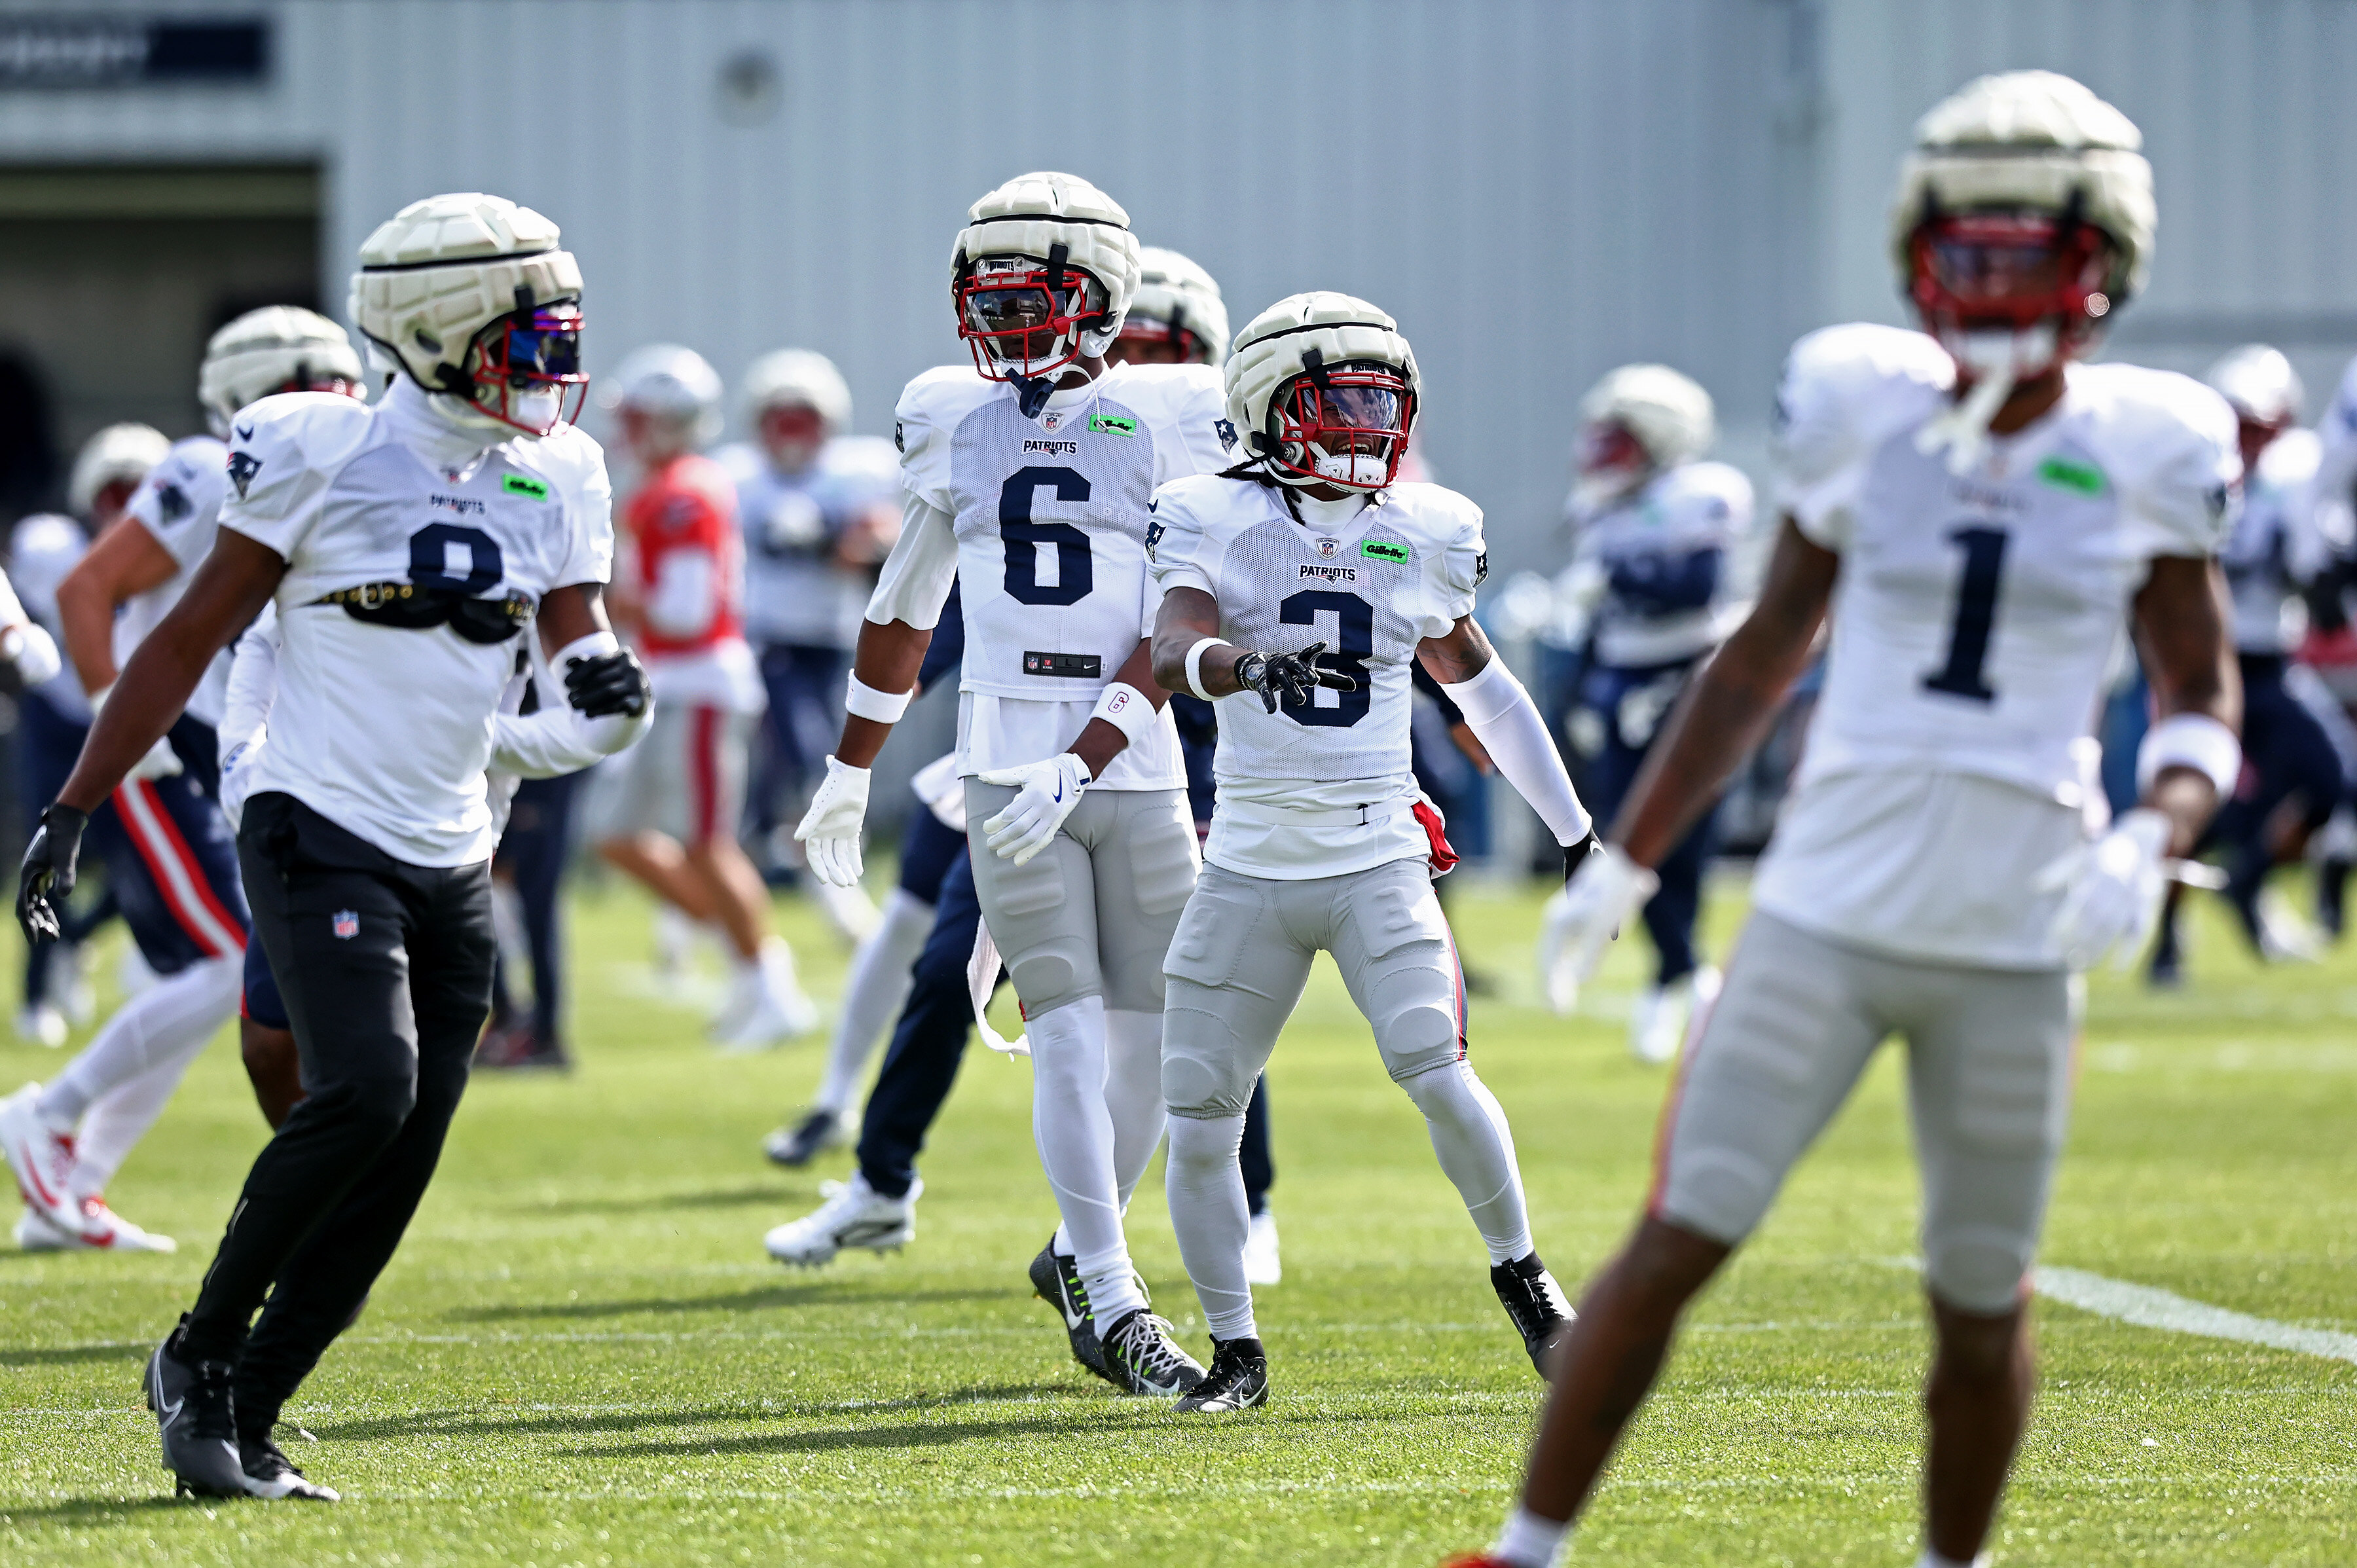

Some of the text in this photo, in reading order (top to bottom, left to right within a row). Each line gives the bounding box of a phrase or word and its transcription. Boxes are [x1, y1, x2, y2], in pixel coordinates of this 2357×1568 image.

[1023, 440, 1077, 454] PATRIOTS
[999, 466, 1093, 606] 6
[1366, 545, 1403, 558] Gillette
[1300, 565, 1355, 581] PATRIOTS
[1926, 528, 2008, 703] 1
[1066, 658, 1072, 666] L
[1279, 589, 1373, 728] 3
[1108, 691, 1129, 714] 6
